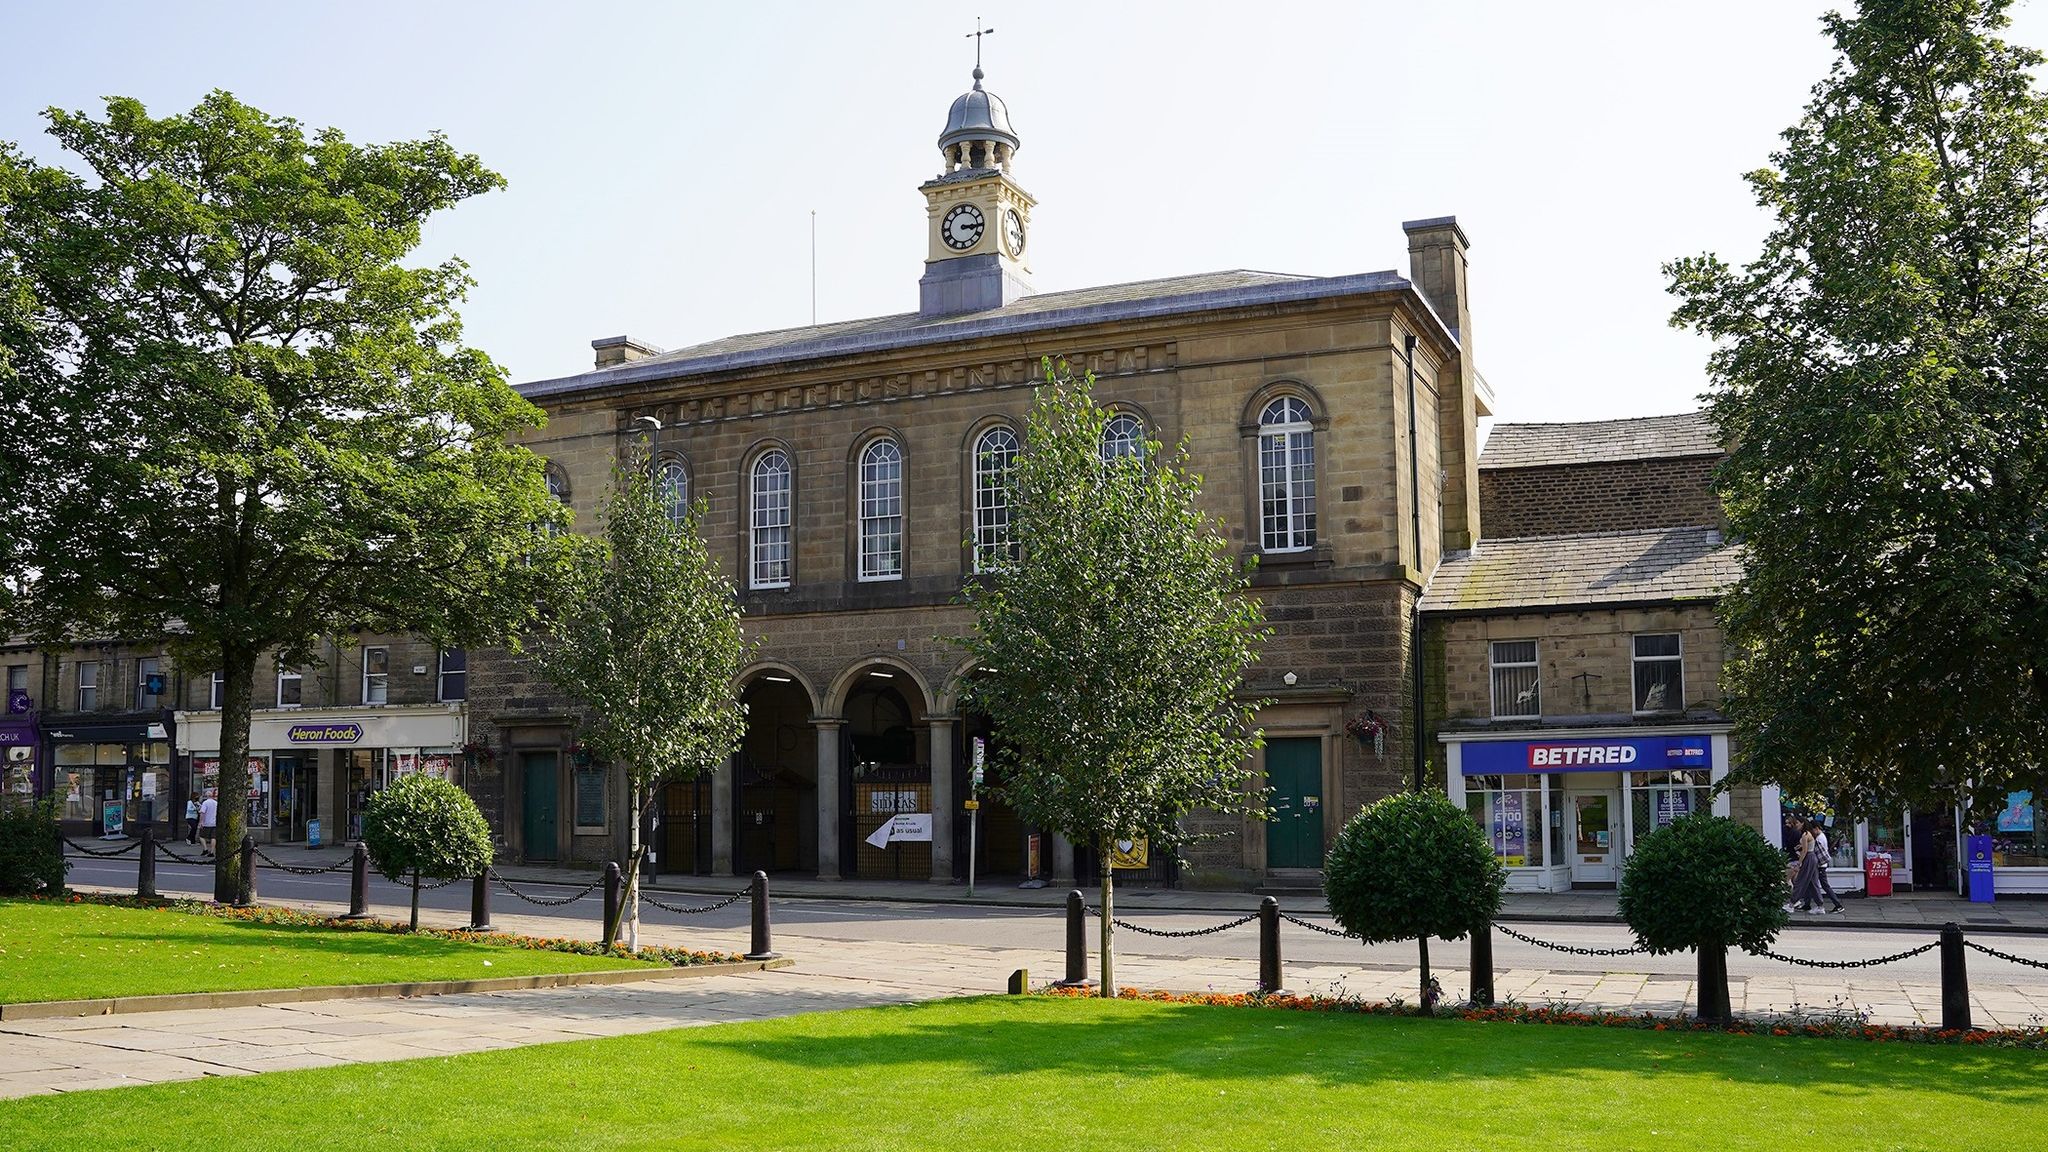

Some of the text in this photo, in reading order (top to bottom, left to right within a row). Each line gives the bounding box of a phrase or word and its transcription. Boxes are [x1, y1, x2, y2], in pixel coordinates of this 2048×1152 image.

[631, 351, 1135, 427] SOLA VIRTUS INVITA
[0, 733, 20, 741] CH UK
[291, 726, 356, 740] Heron Foods
[1533, 745, 1637, 766] BETFRED
